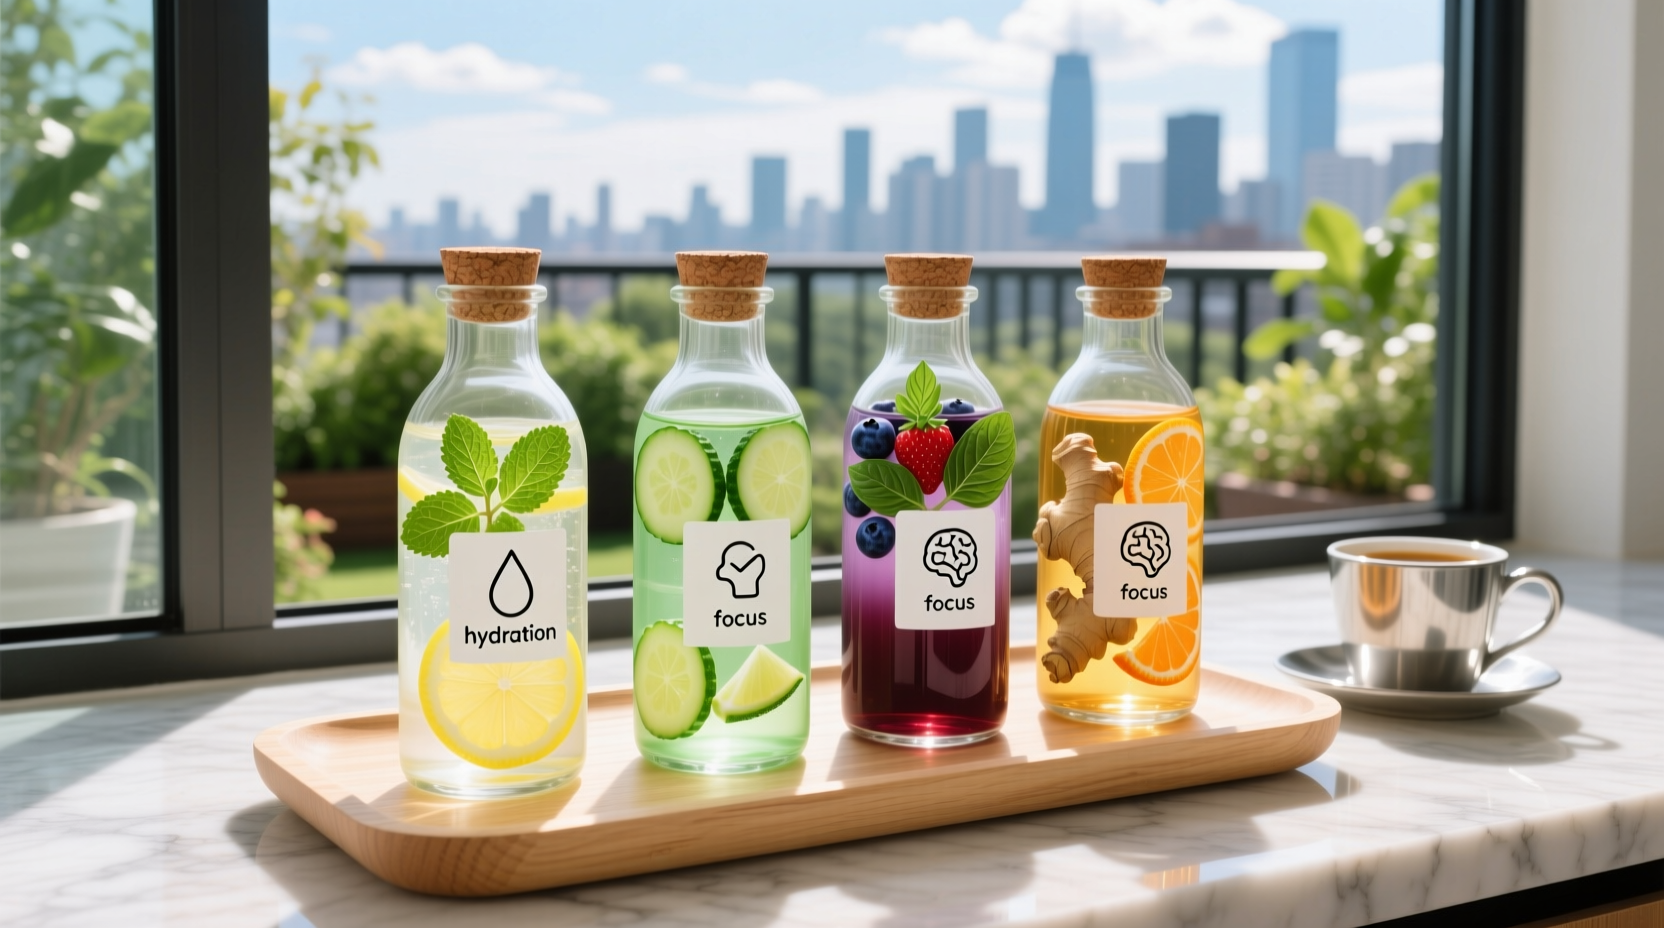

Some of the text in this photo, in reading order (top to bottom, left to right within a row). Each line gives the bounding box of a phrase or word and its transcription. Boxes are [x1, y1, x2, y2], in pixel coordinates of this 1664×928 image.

[1120, 583, 1168, 601] focus
[923, 594, 975, 612] focus
[713, 609, 767, 628] focus
[464, 623, 557, 649] hydration
